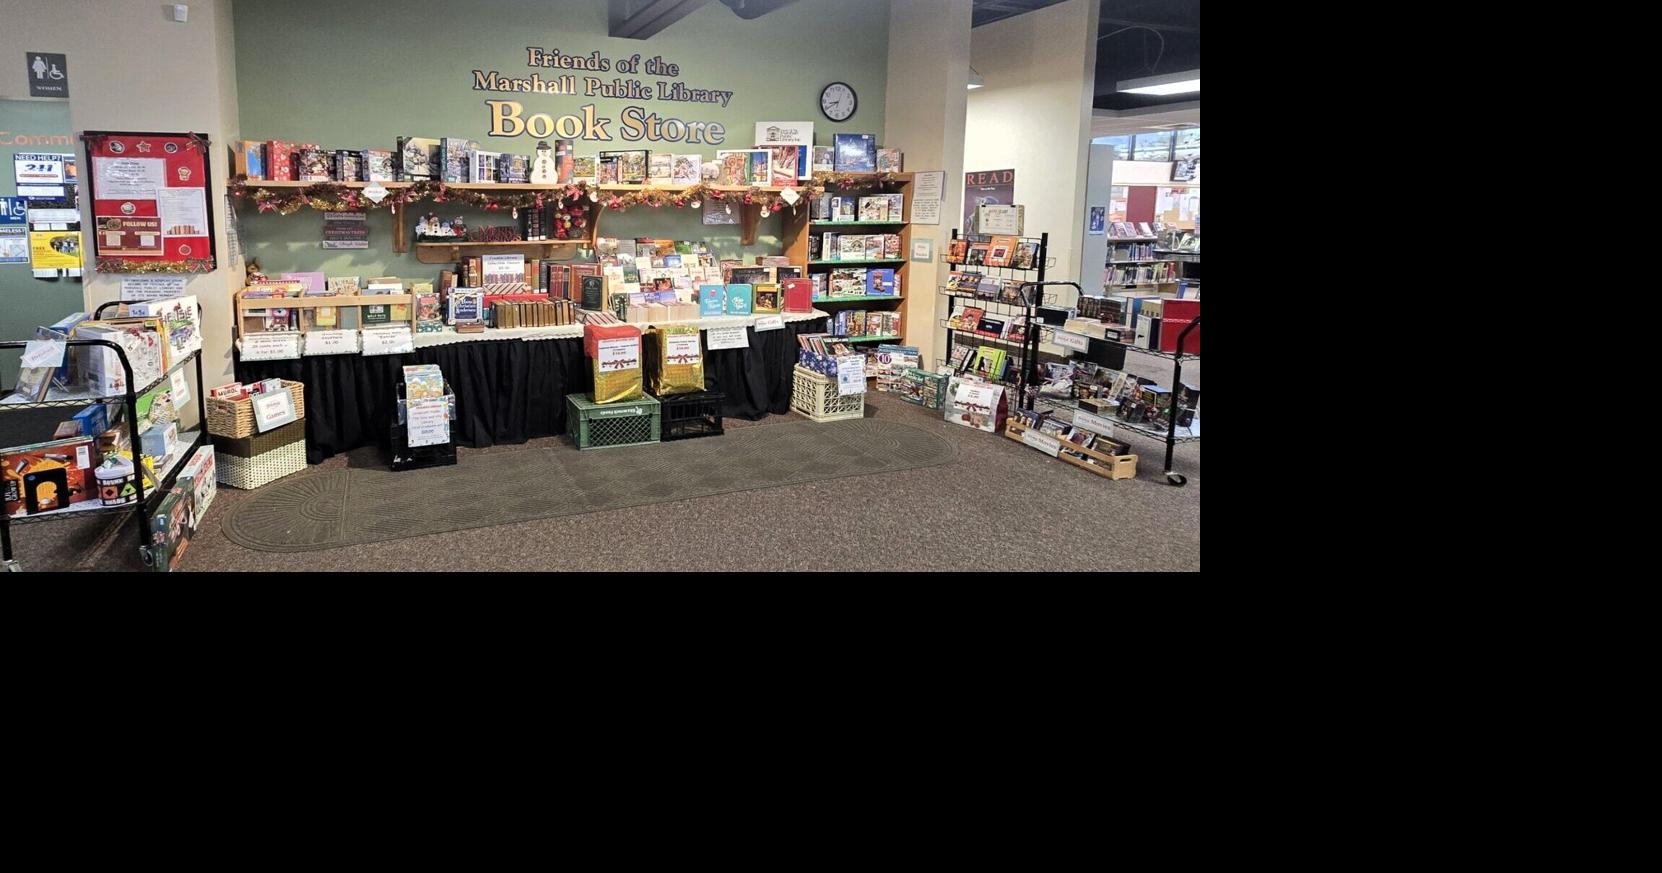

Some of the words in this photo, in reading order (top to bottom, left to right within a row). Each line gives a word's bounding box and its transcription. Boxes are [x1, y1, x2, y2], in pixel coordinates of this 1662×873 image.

[526, 46, 610, 73] Friends
[616, 54, 641, 74] of
[645, 56, 679, 77] the
[472, 70, 577, 96] Marshall
[583, 76, 653, 101] Public
[656, 81, 733, 108] Library
[485, 99, 613, 142] Book
[620, 106, 726, 145] Store
[37, 154, 62, 162] HELP?
[966, 171, 1013, 185] READ
[882, 354, 890, 363] 10
